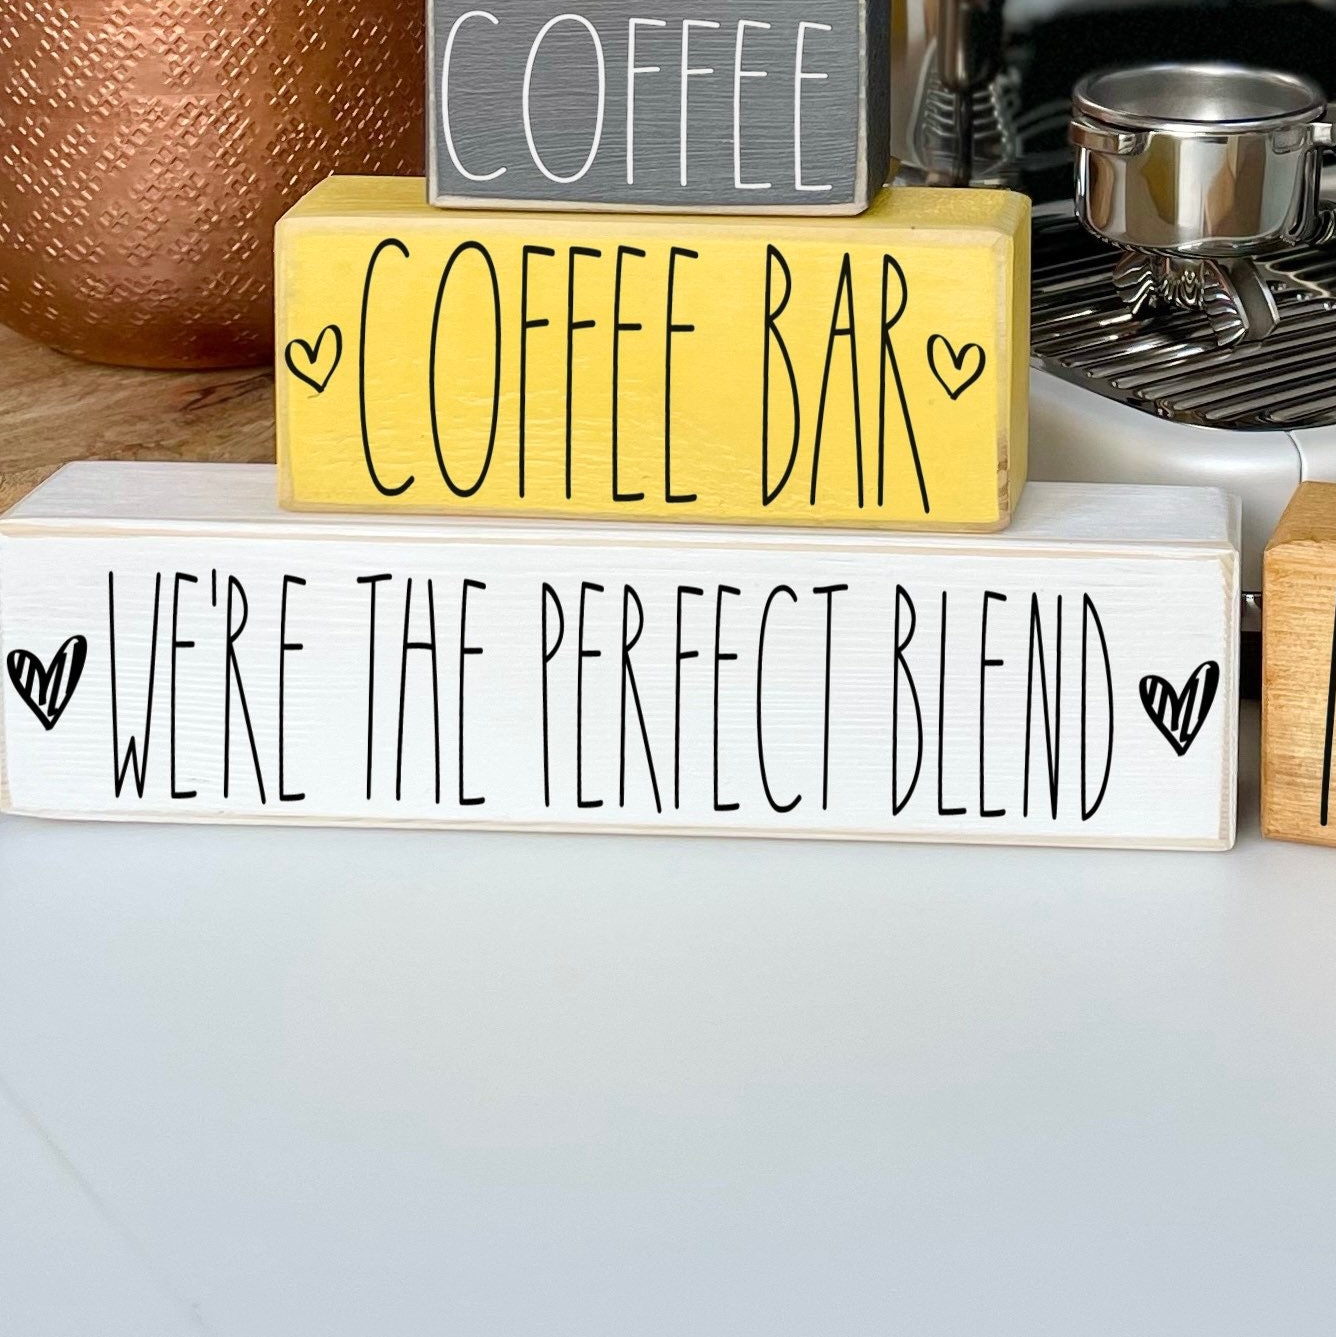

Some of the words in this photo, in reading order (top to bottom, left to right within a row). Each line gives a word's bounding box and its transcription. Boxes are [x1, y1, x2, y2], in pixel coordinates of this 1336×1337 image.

[440, 9, 833, 192] COFFEE
[357, 237, 700, 505] COFFEE
[761, 243, 931, 515] BAR
[107, 567, 308, 806] WE'RE
[355, 572, 488, 807] THE
[540, 580, 850, 815] PERFECT
[891, 583, 1115, 823] BLEND
